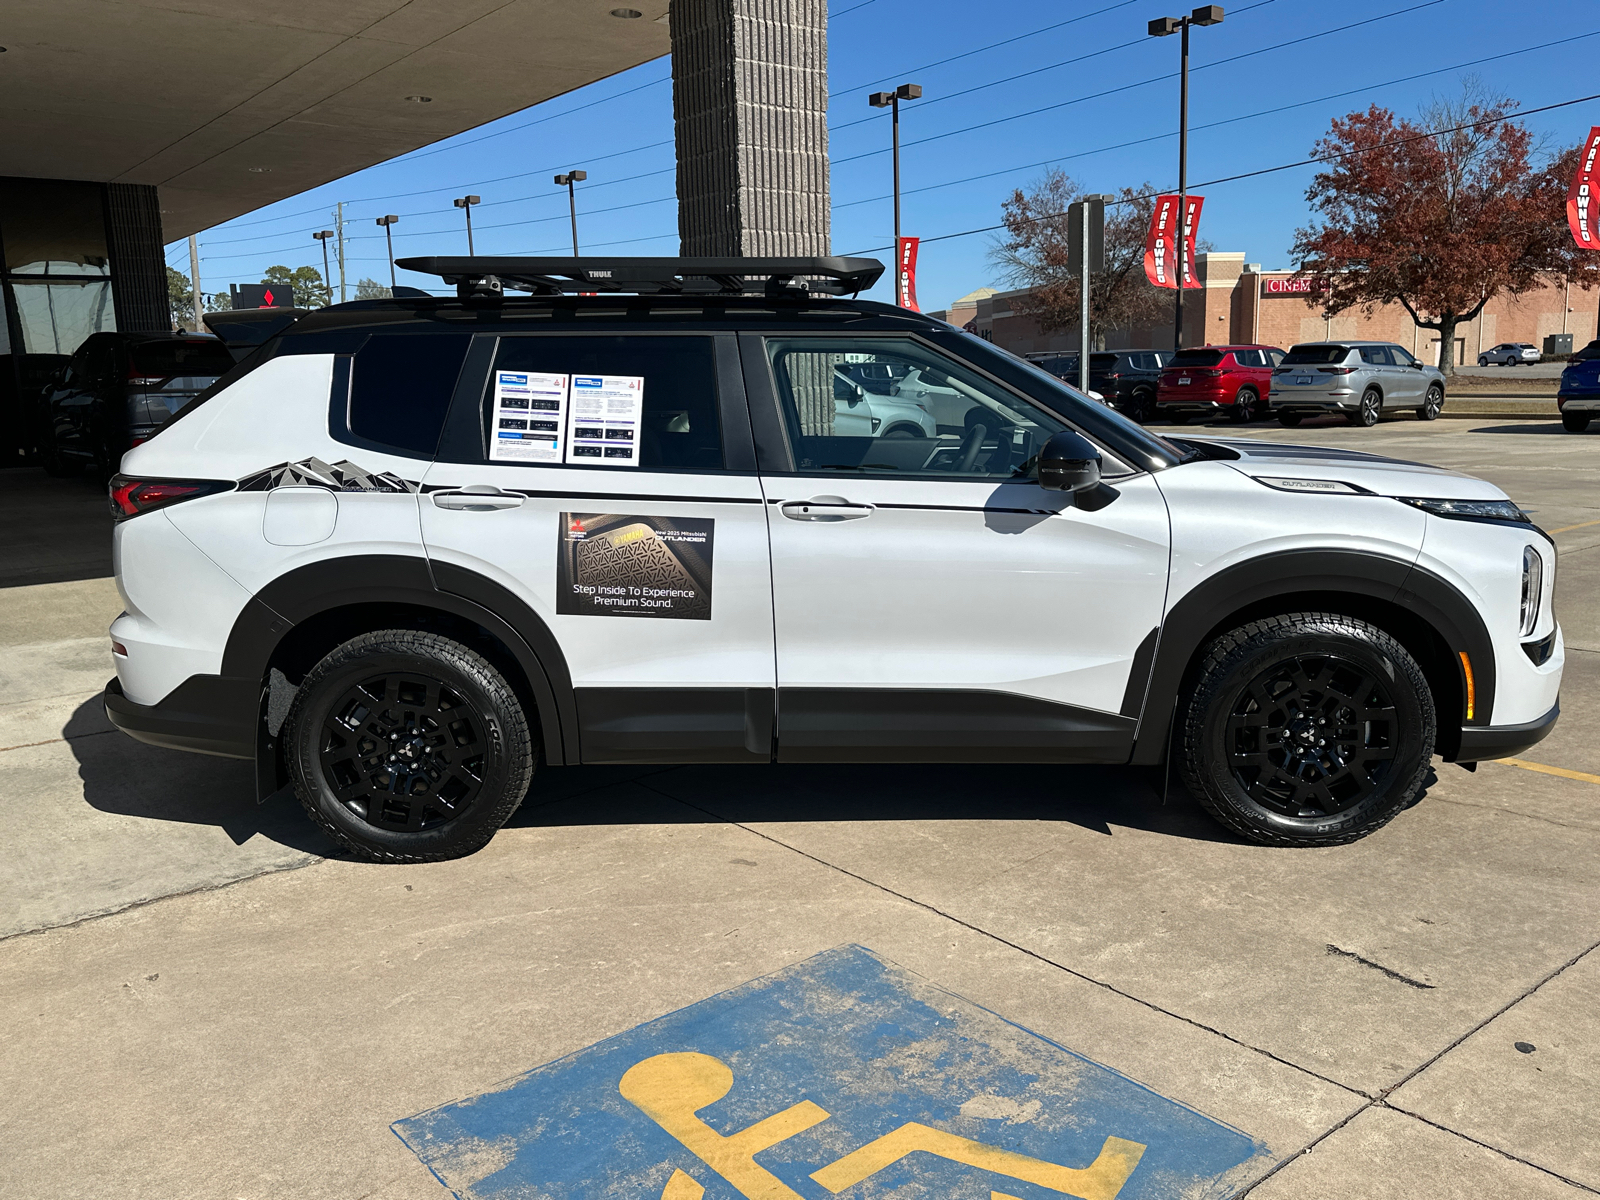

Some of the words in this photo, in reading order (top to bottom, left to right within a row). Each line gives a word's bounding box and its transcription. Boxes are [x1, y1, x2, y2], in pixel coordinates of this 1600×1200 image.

[1577, 136, 1600, 242] PRE-OWNED
[1184, 203, 1196, 236] NEW
[1153, 202, 1170, 284] PRE-OWNED
[1183, 240, 1191, 283] CARS
[588, 270, 612, 278] THULE
[901, 243, 911, 307] PRE-OWNED
[1282, 481, 1334, 489] OUTLANDER
[620, 529, 644, 544] YAMAHA
[655, 535, 706, 543] OUTLANDER
[573, 584, 596, 595] Step
[597, 585, 626, 595] Inside
[628, 586, 641, 596] To
[642, 587, 695, 599] Experience
[594, 596, 639, 607] Premium
[640, 597, 674, 608] Sound.
